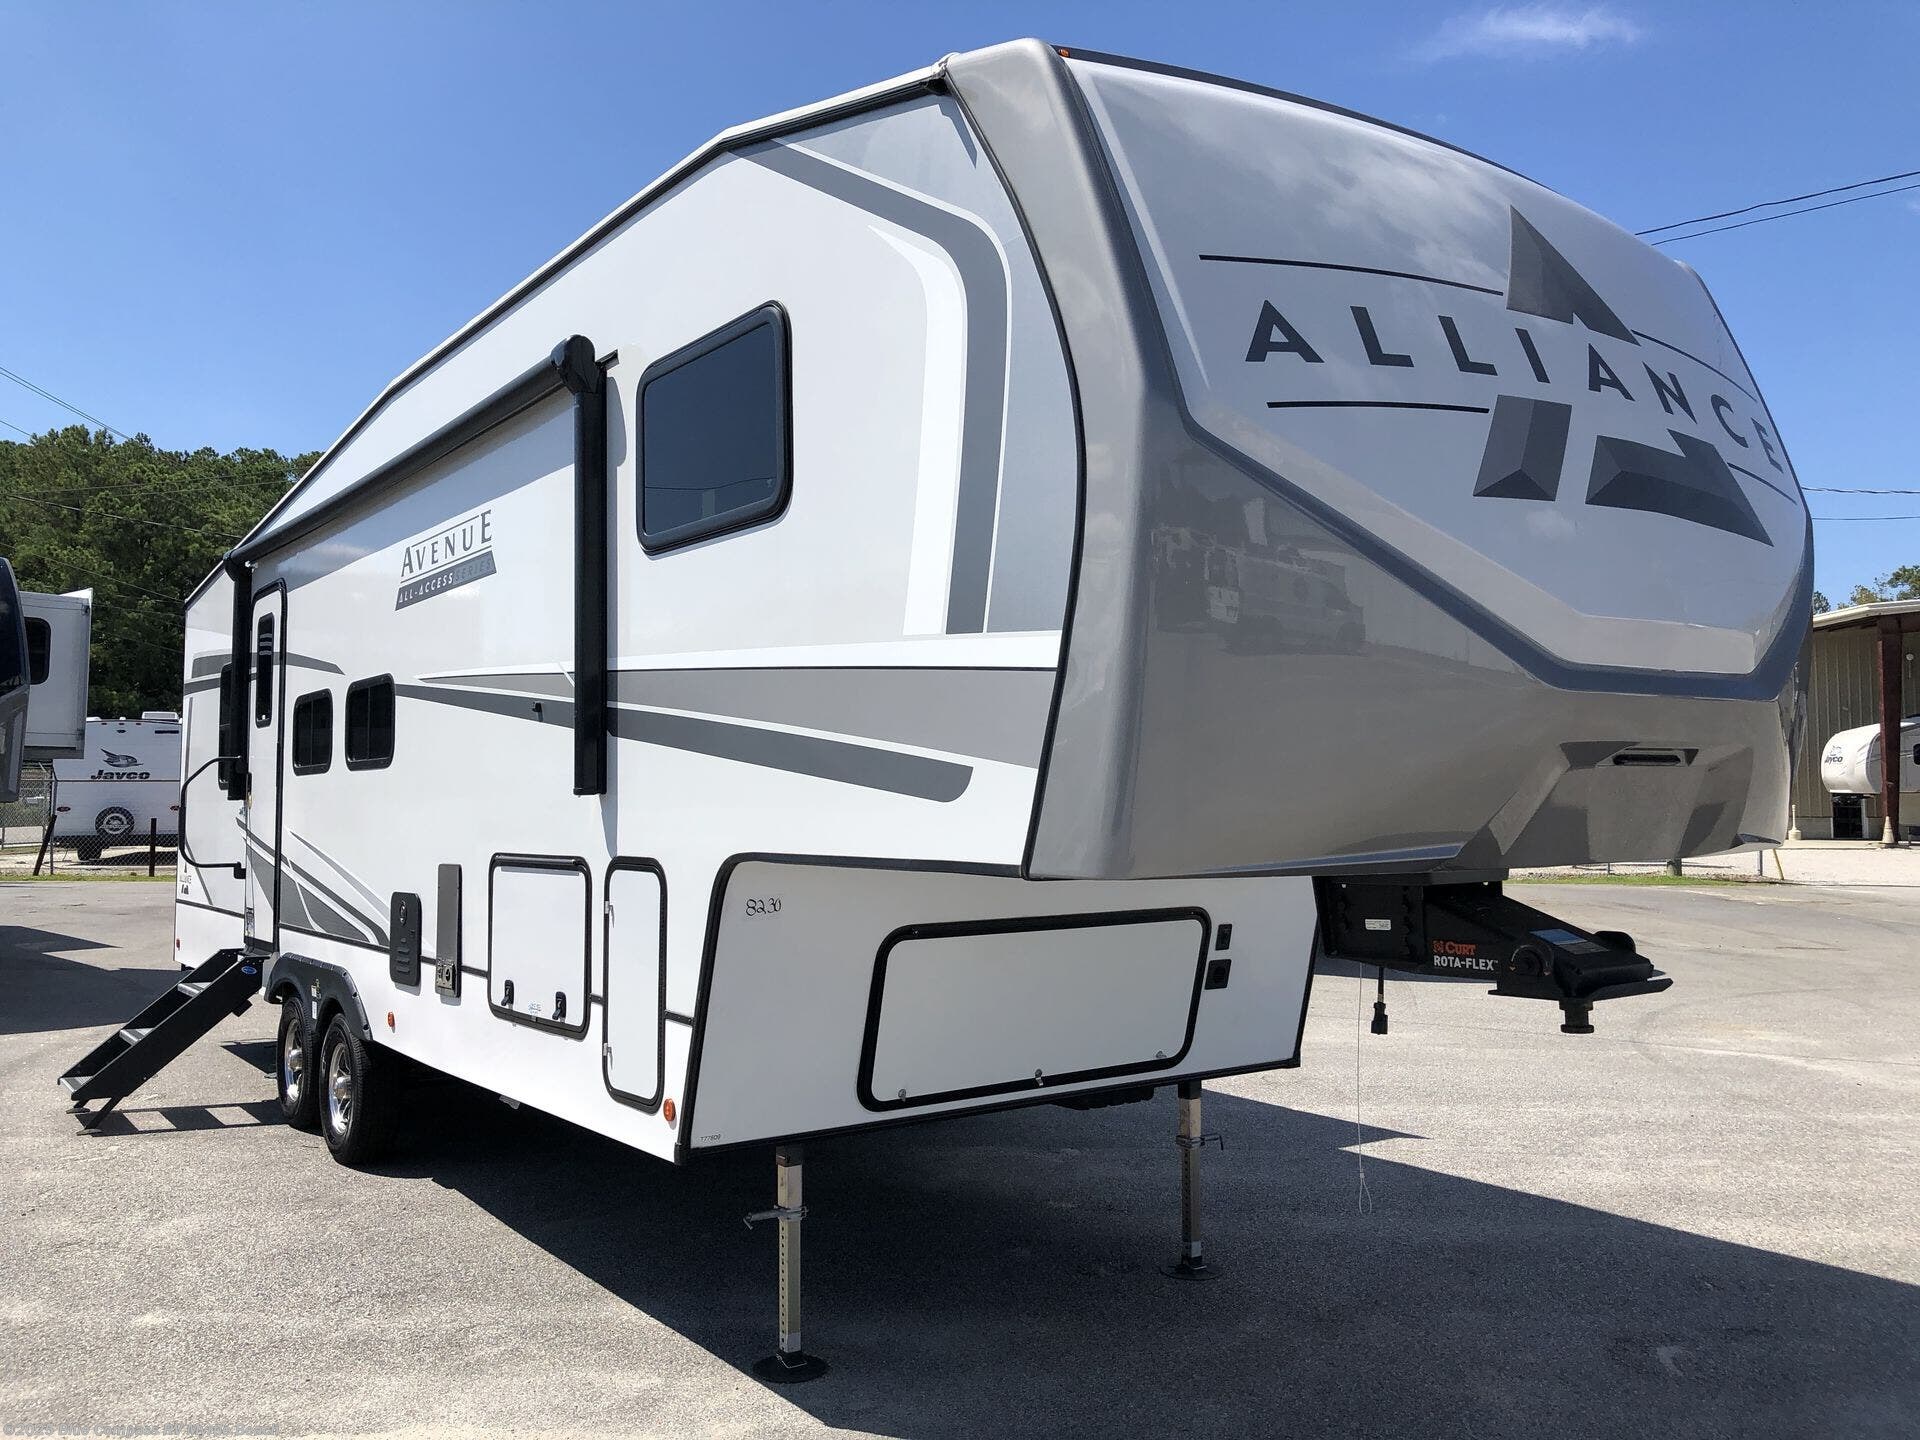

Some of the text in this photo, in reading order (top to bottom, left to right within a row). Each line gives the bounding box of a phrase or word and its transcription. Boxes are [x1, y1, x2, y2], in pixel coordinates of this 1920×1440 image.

[1245, 300, 1783, 473] ALLIANCE
[401, 509, 492, 577] AVENUE
[90, 769, 151, 780] Jayco
[745, 897, 782, 916] 8230
